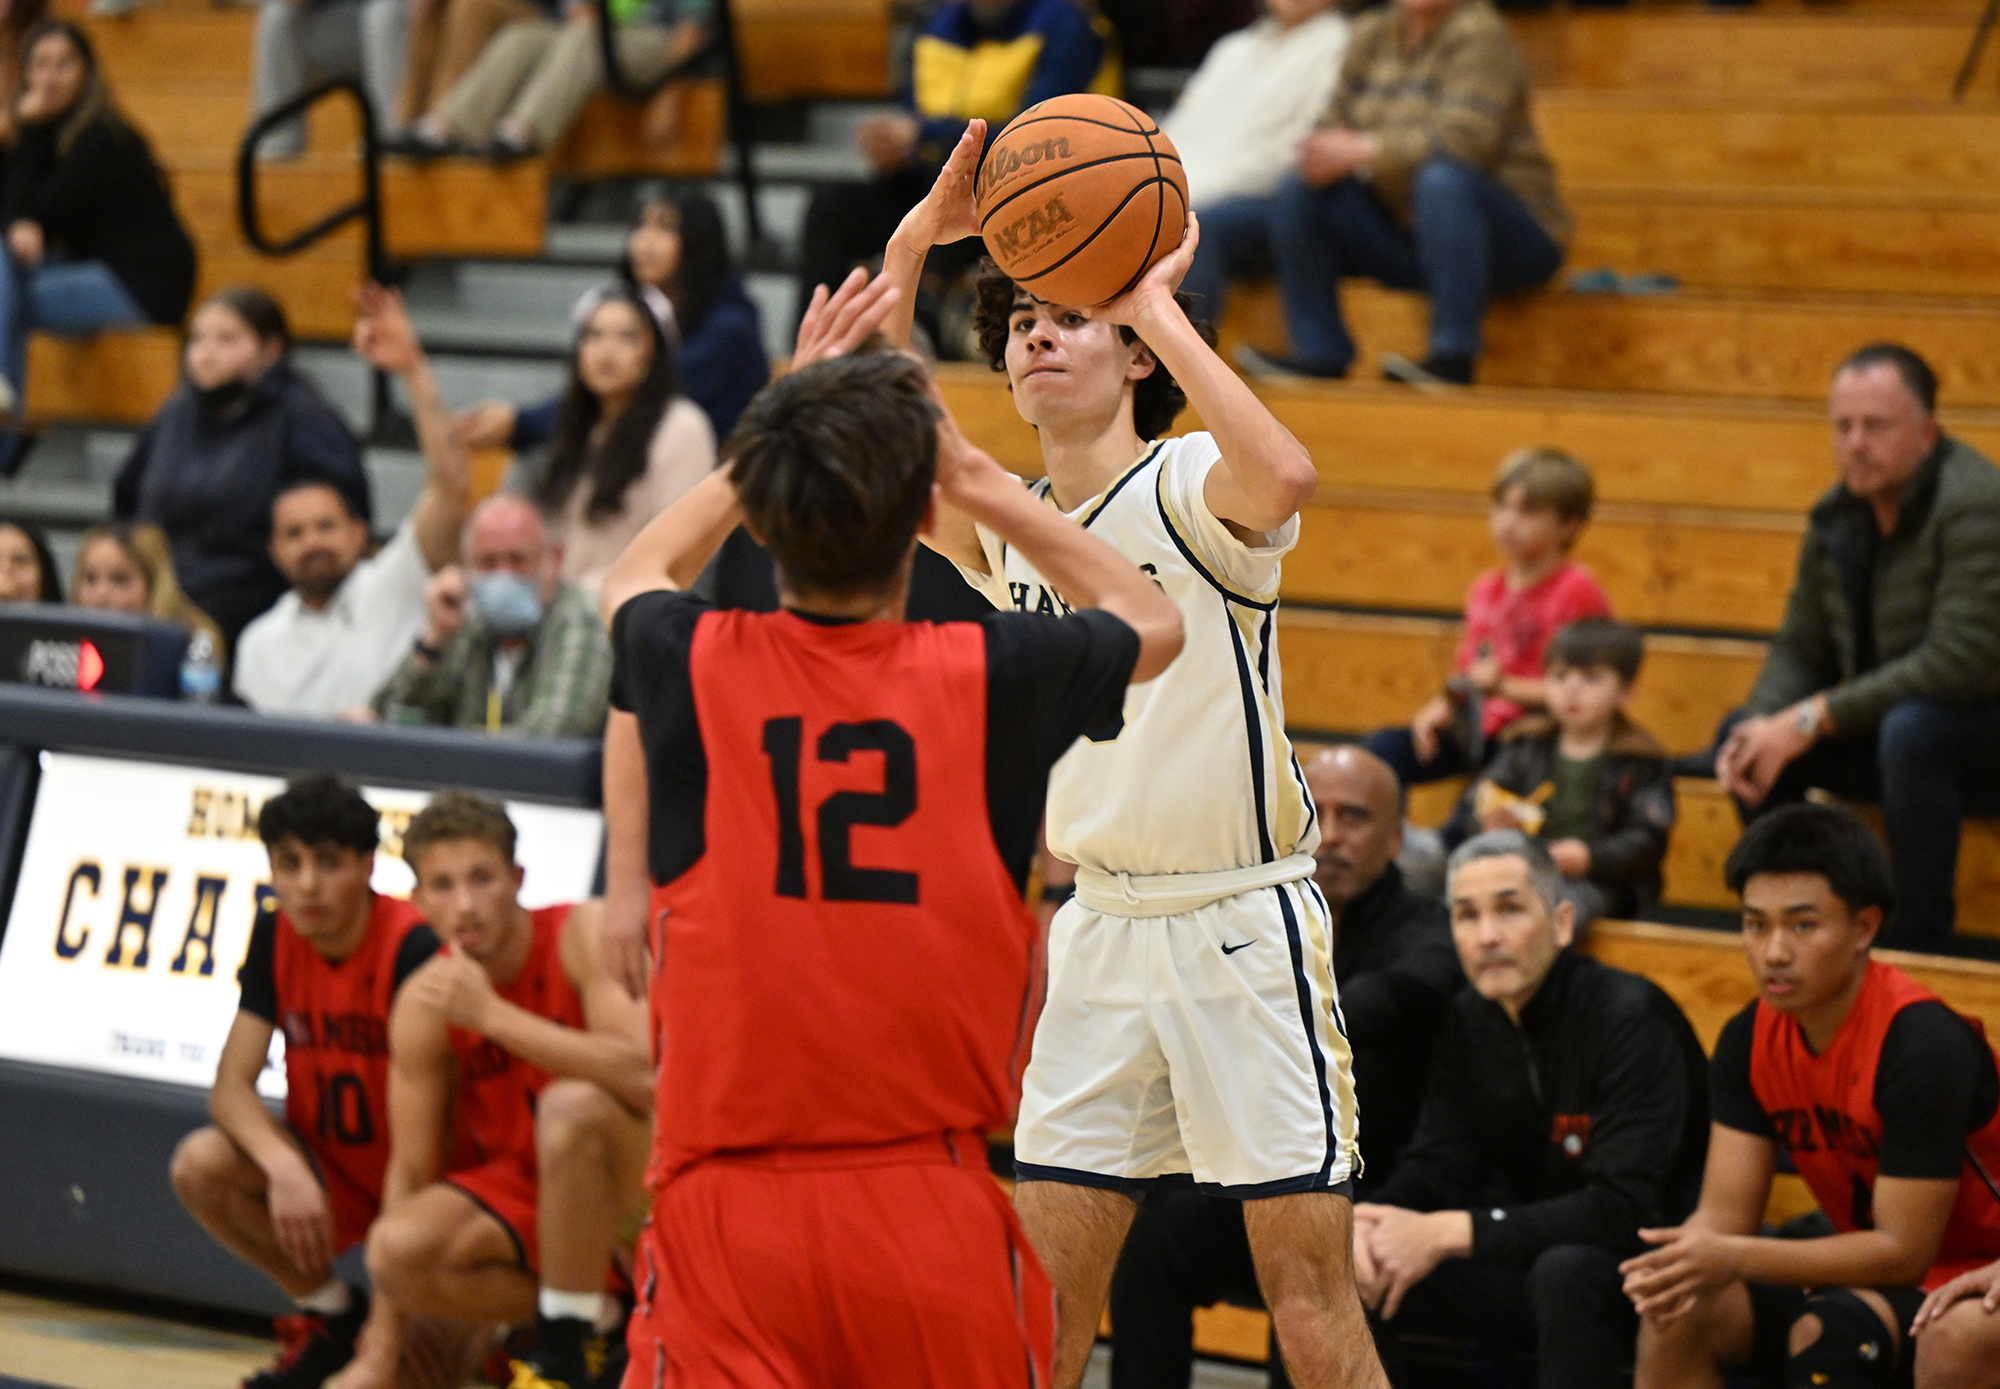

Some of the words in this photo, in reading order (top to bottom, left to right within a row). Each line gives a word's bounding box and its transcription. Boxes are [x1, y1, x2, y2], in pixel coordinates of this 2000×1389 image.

[993, 196, 1074, 261] NCAA
[763, 716, 919, 904] 12
[315, 1069, 375, 1144] 10
